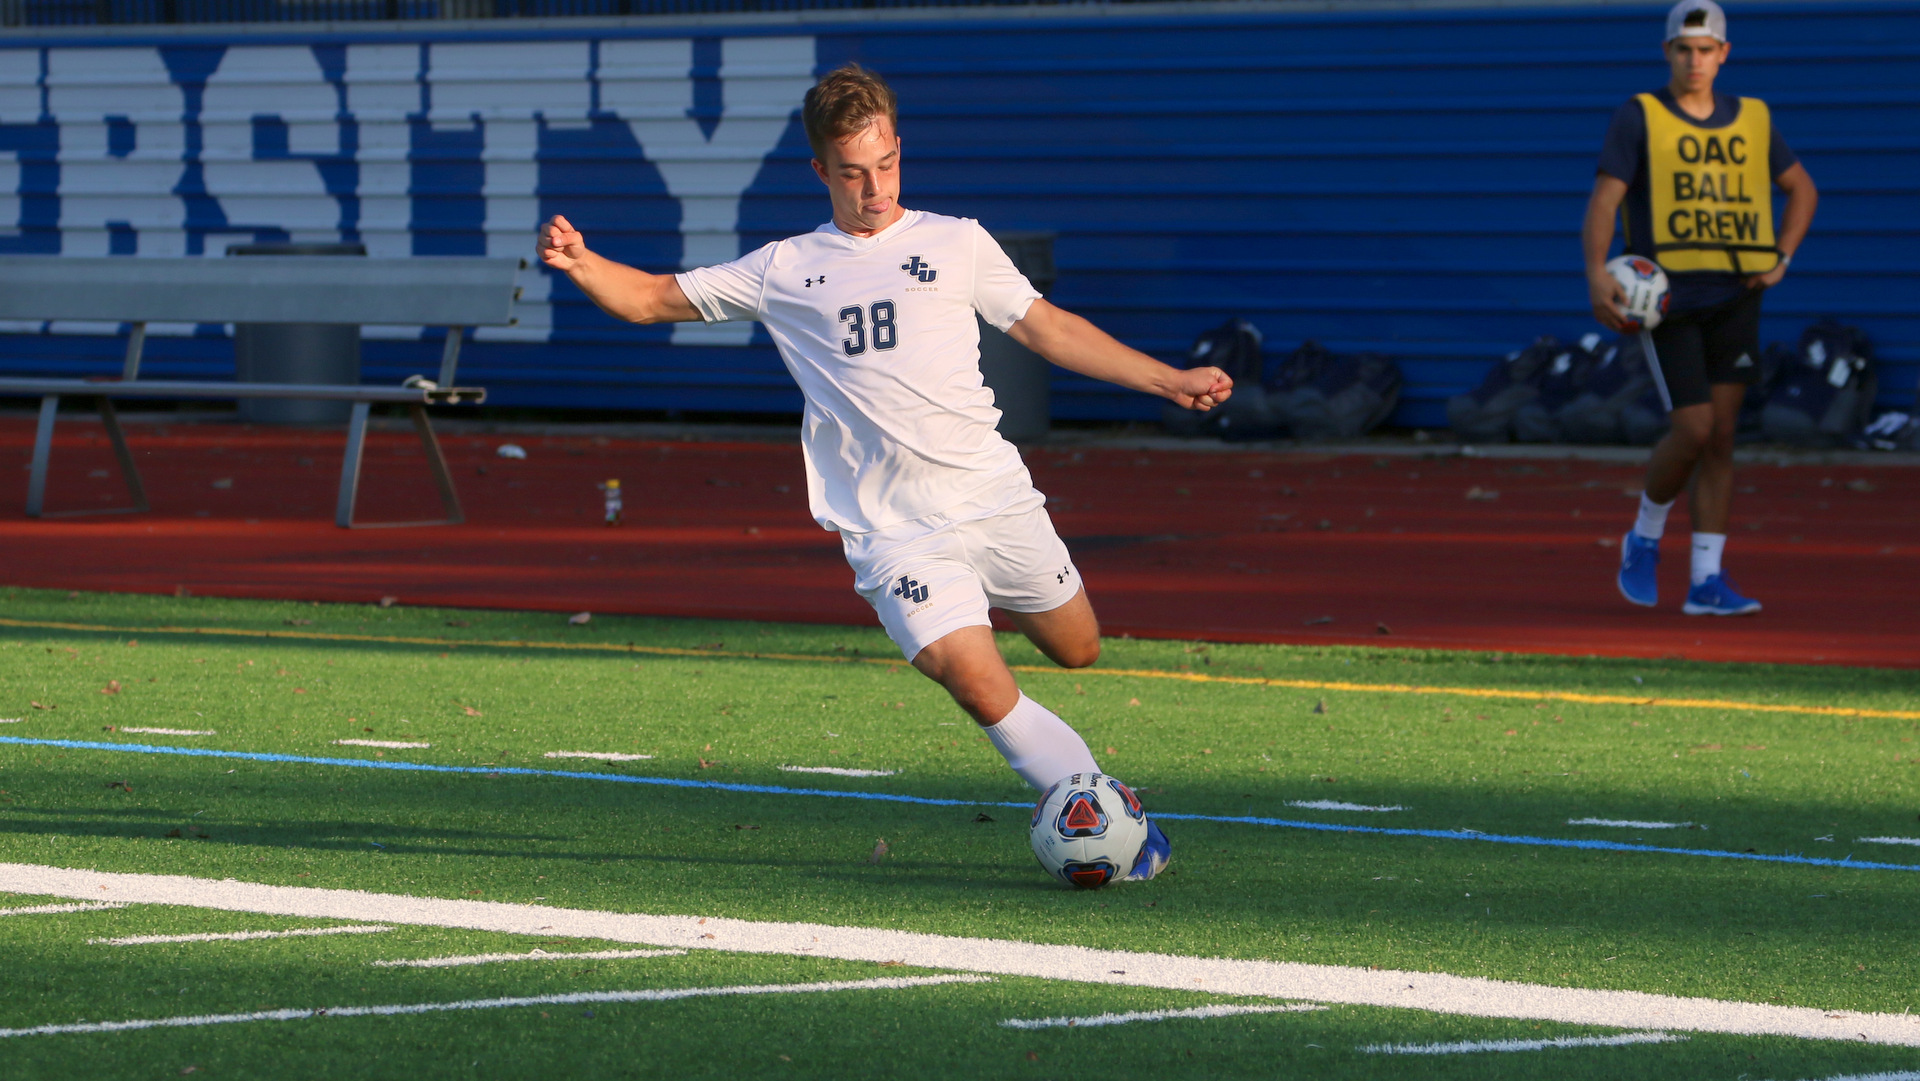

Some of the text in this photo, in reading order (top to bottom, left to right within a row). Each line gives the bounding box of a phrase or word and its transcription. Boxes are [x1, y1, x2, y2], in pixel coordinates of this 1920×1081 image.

[1677, 134, 1747, 165] OAC
[1673, 172, 1753, 203] BALL
[1667, 210, 1760, 241] CREW
[901, 255, 938, 283] JCU
[838, 299, 898, 358] 38
[894, 574, 930, 604] JCU
[906, 602, 933, 618] SOCCER
